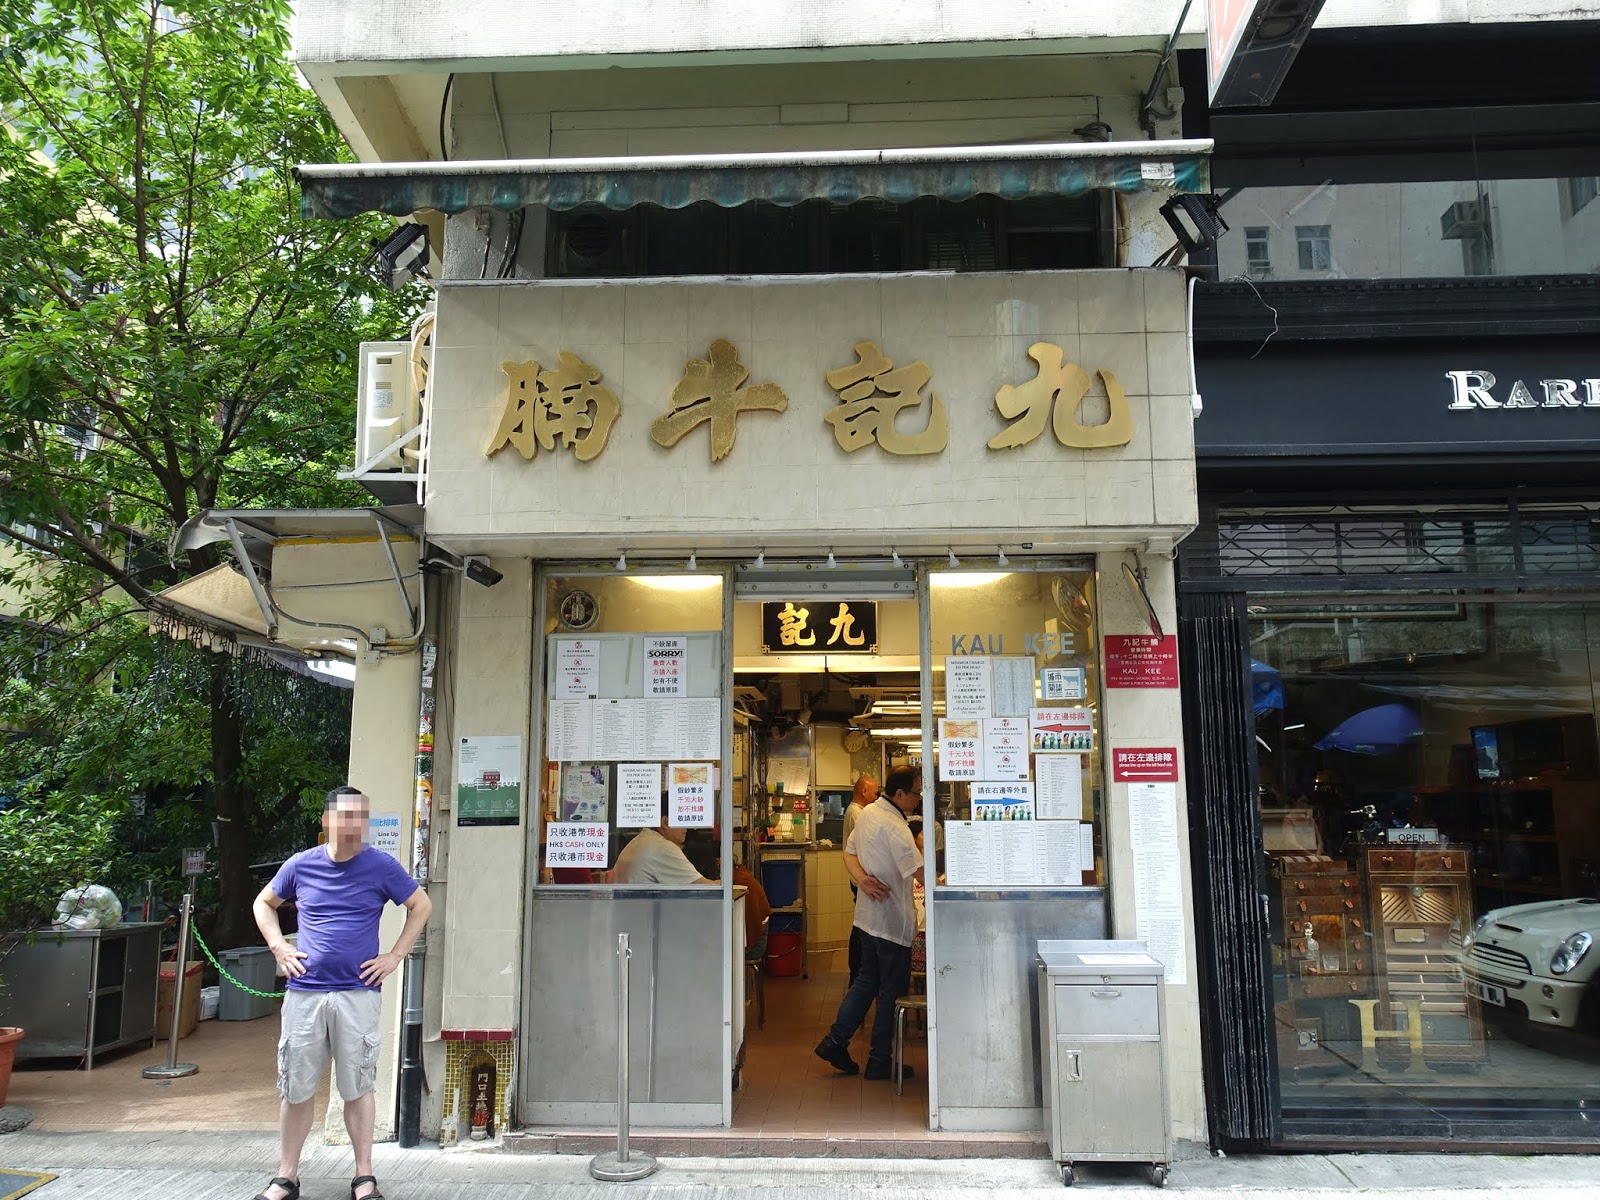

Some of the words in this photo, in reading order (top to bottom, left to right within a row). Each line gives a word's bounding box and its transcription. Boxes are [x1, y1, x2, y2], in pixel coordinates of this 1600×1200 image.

[777, 602, 865, 646] 九記
[952, 634, 1003, 656] KAU
[1024, 632, 1076, 655] KEE
[1123, 638, 1159, 646] 九記牛腩
[649, 650, 683, 658] SORRY!
[1118, 753, 1173, 762] 請在左邊排隊
[550, 827, 605, 837] 只收港幣現金
[1398, 833, 1426, 841] OPEN
[549, 852, 605, 862] 只收港币现金
[1348, 999, 1438, 1074] H
